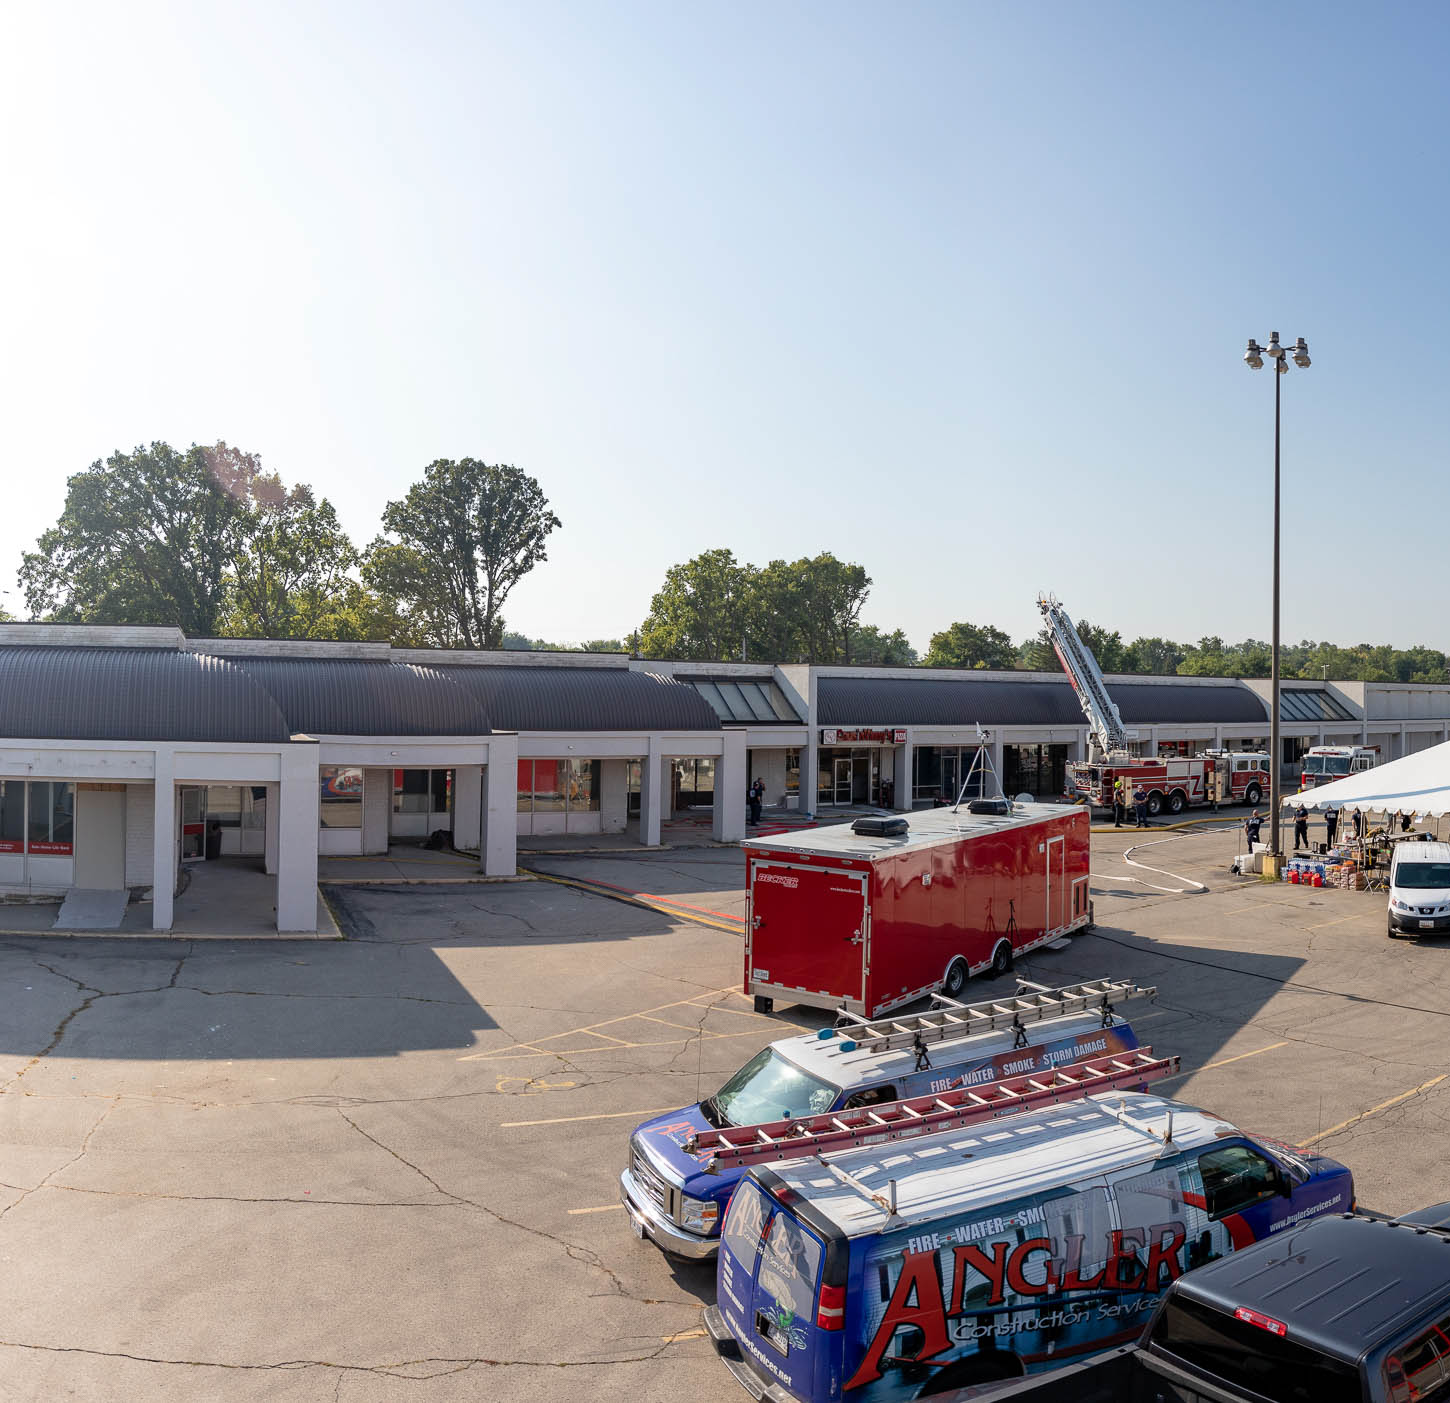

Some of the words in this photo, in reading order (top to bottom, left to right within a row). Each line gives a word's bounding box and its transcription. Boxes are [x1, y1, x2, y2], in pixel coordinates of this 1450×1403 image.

[757, 873, 799, 886] BECKER
[930, 1079, 953, 1093] FIRE
[960, 1068, 995, 1086] WATER
[1002, 1057, 1036, 1076] SMOKE
[1042, 1048, 1074, 1066] STORM
[1073, 1038, 1108, 1057] DAMAGE
[1269, 1193, 1342, 1233] www.AnglerServices.net
[908, 1233, 941, 1256] FIRE
[954, 1217, 1006, 1244] WATER
[842, 1220, 1187, 1392] ANGLER
[953, 1310, 1090, 1341] Construction
